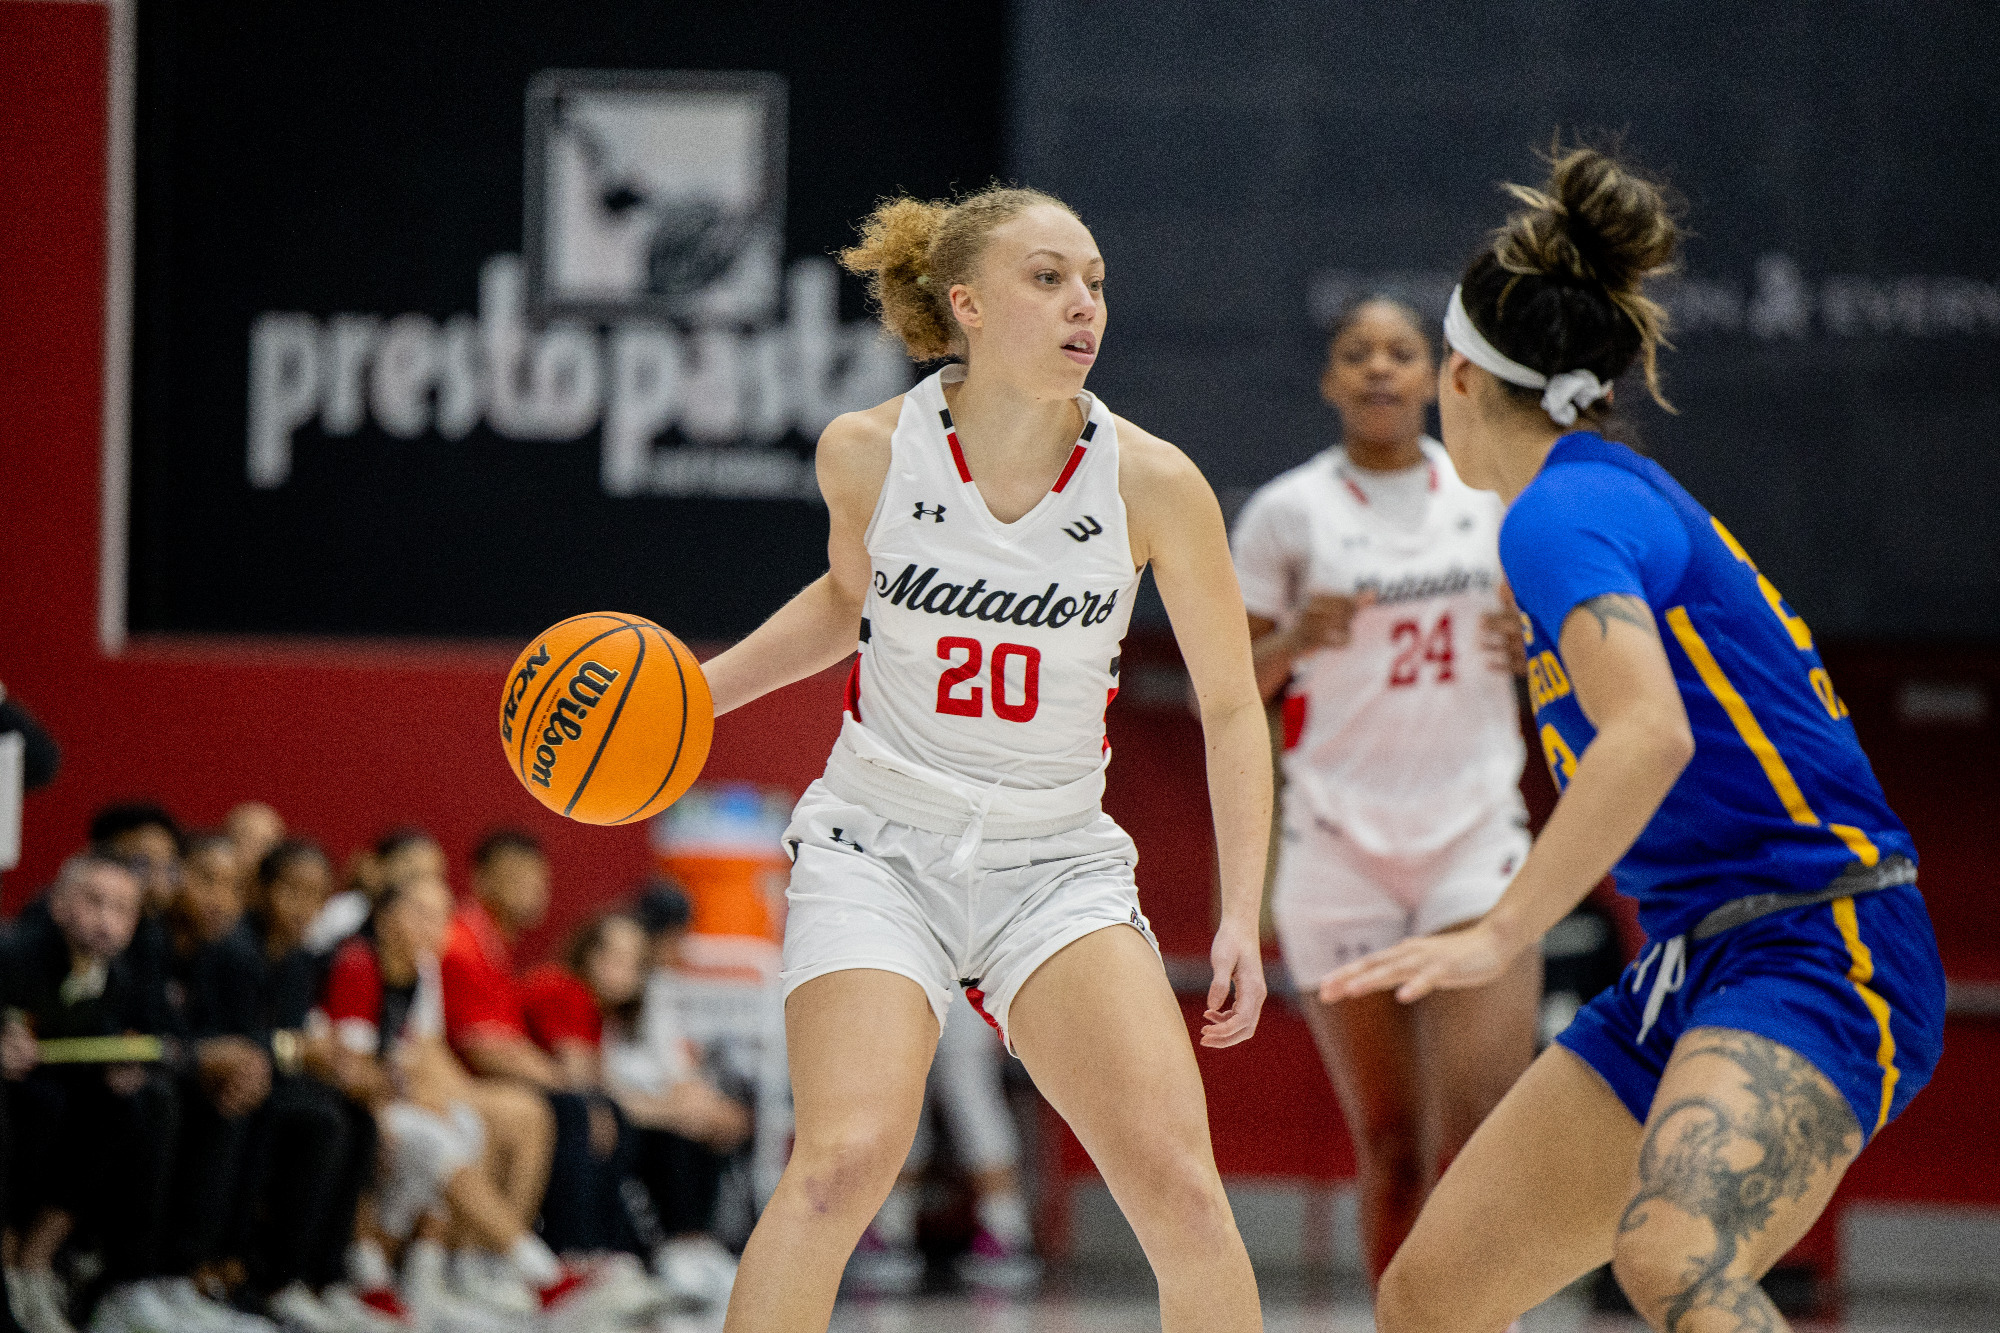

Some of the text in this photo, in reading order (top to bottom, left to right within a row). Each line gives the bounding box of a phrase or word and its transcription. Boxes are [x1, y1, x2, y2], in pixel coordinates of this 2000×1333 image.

[874, 563, 1119, 628] Matadors
[502, 643, 551, 744] NCAA
[936, 635, 1041, 723] 20
[1388, 612, 1455, 689] 24
[531, 660, 621, 788] Wilson
